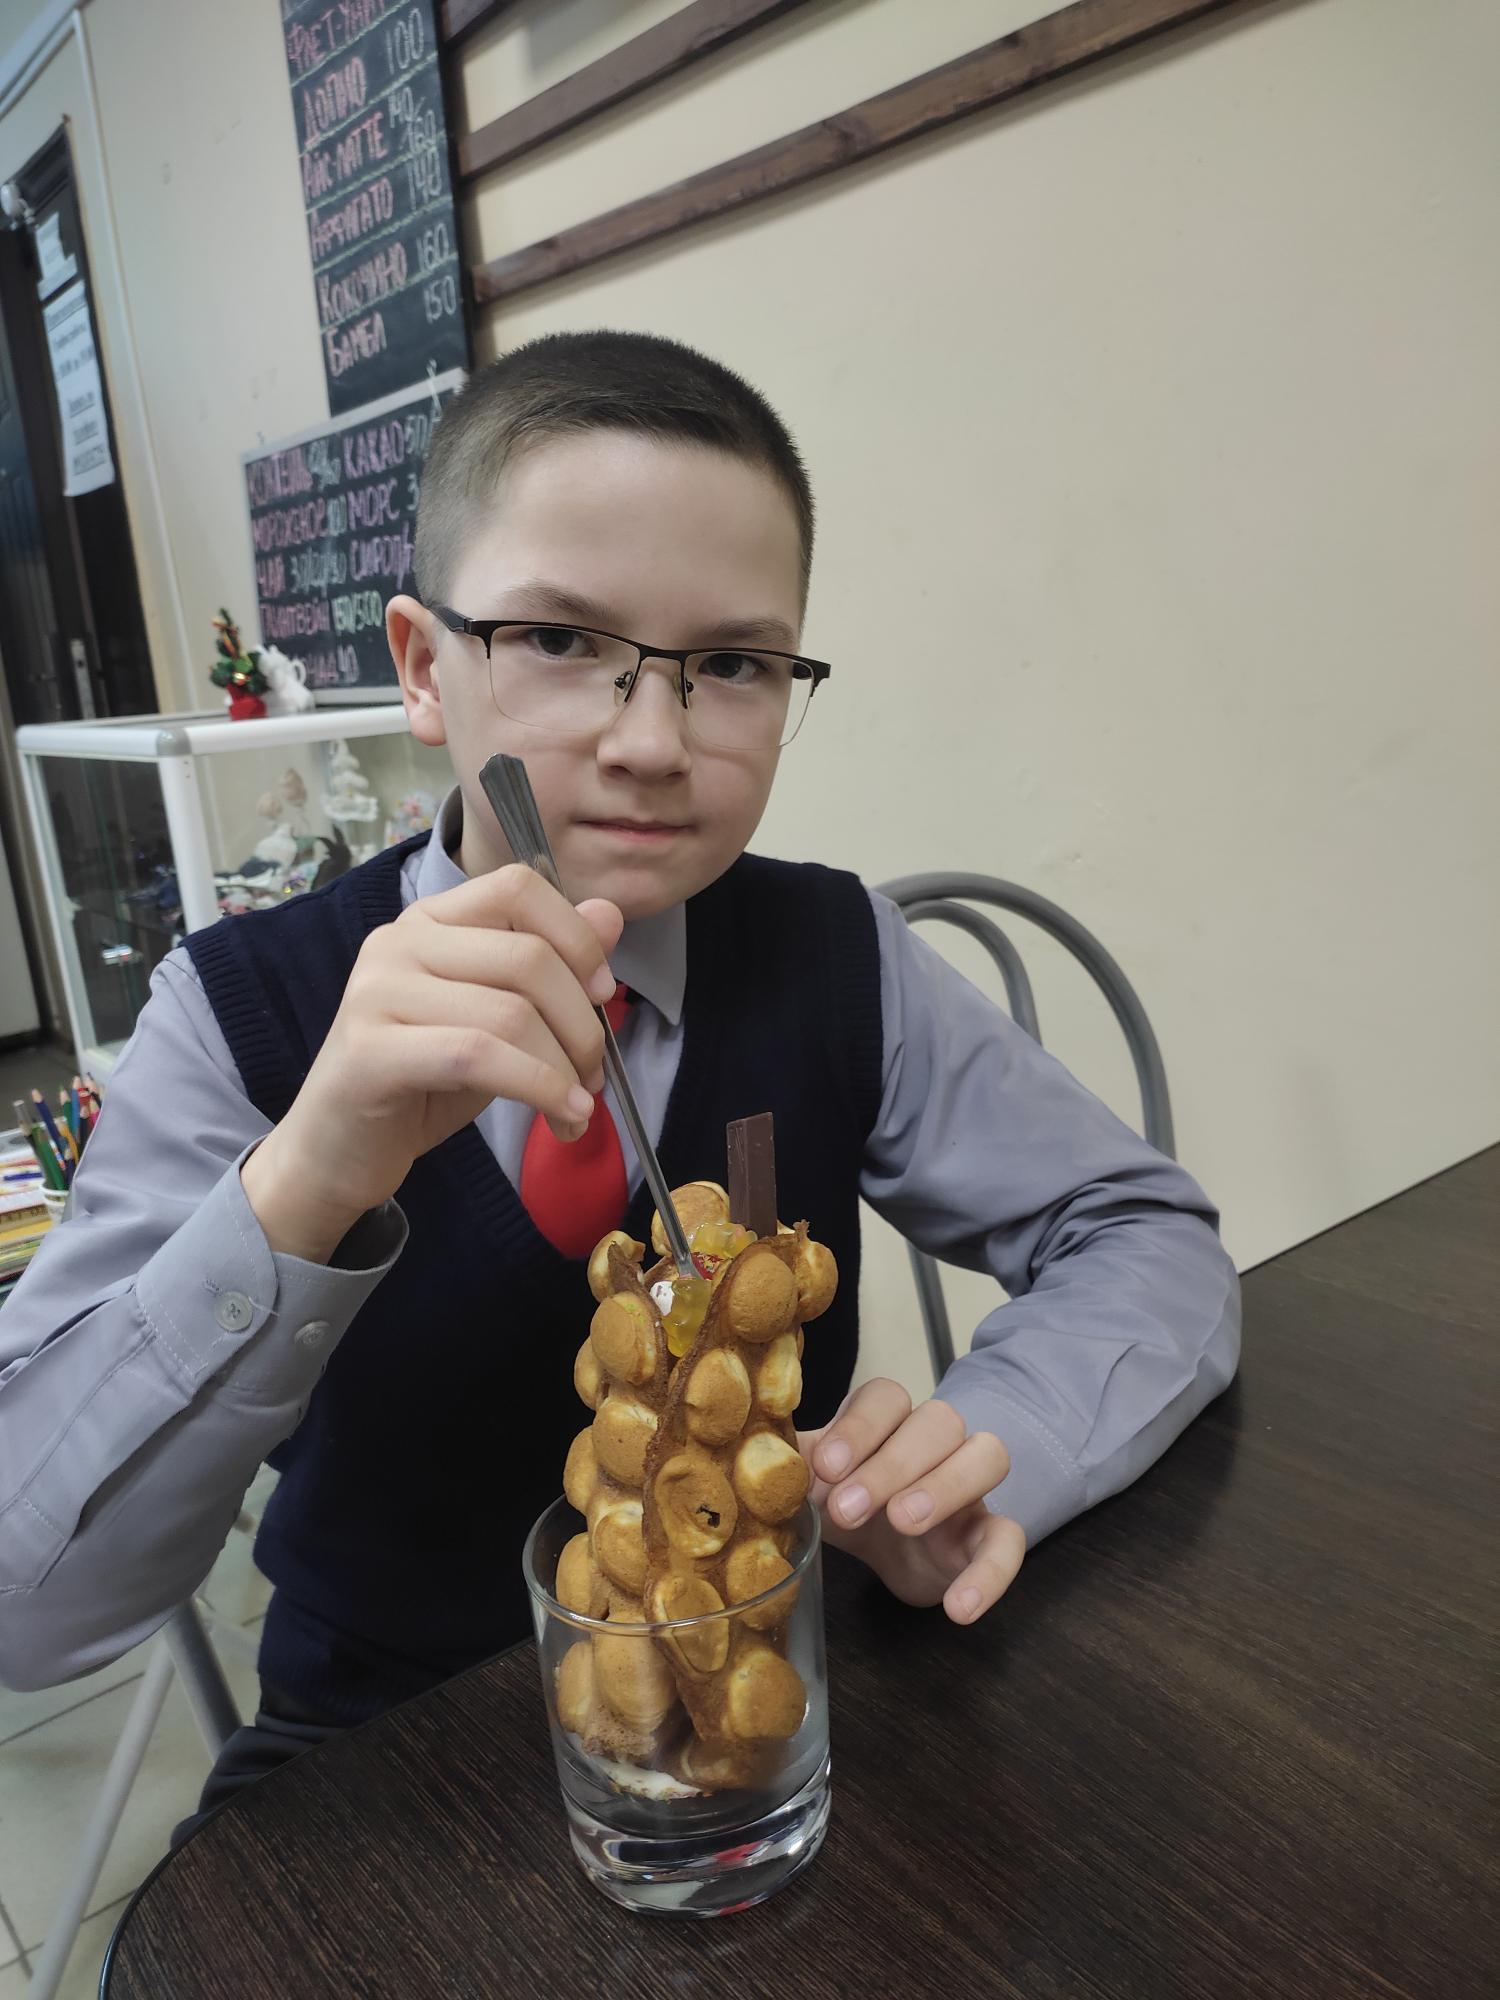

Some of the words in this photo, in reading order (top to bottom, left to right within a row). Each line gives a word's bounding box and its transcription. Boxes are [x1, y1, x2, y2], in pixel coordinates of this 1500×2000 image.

[386, 8, 425, 75] 100
[416, 222, 450, 273] 160
[423, 275, 457, 324] 150
[344, 420, 406, 479] КАКАО
[348, 477, 400, 531] МОРС
[406, 473, 420, 511] 3
